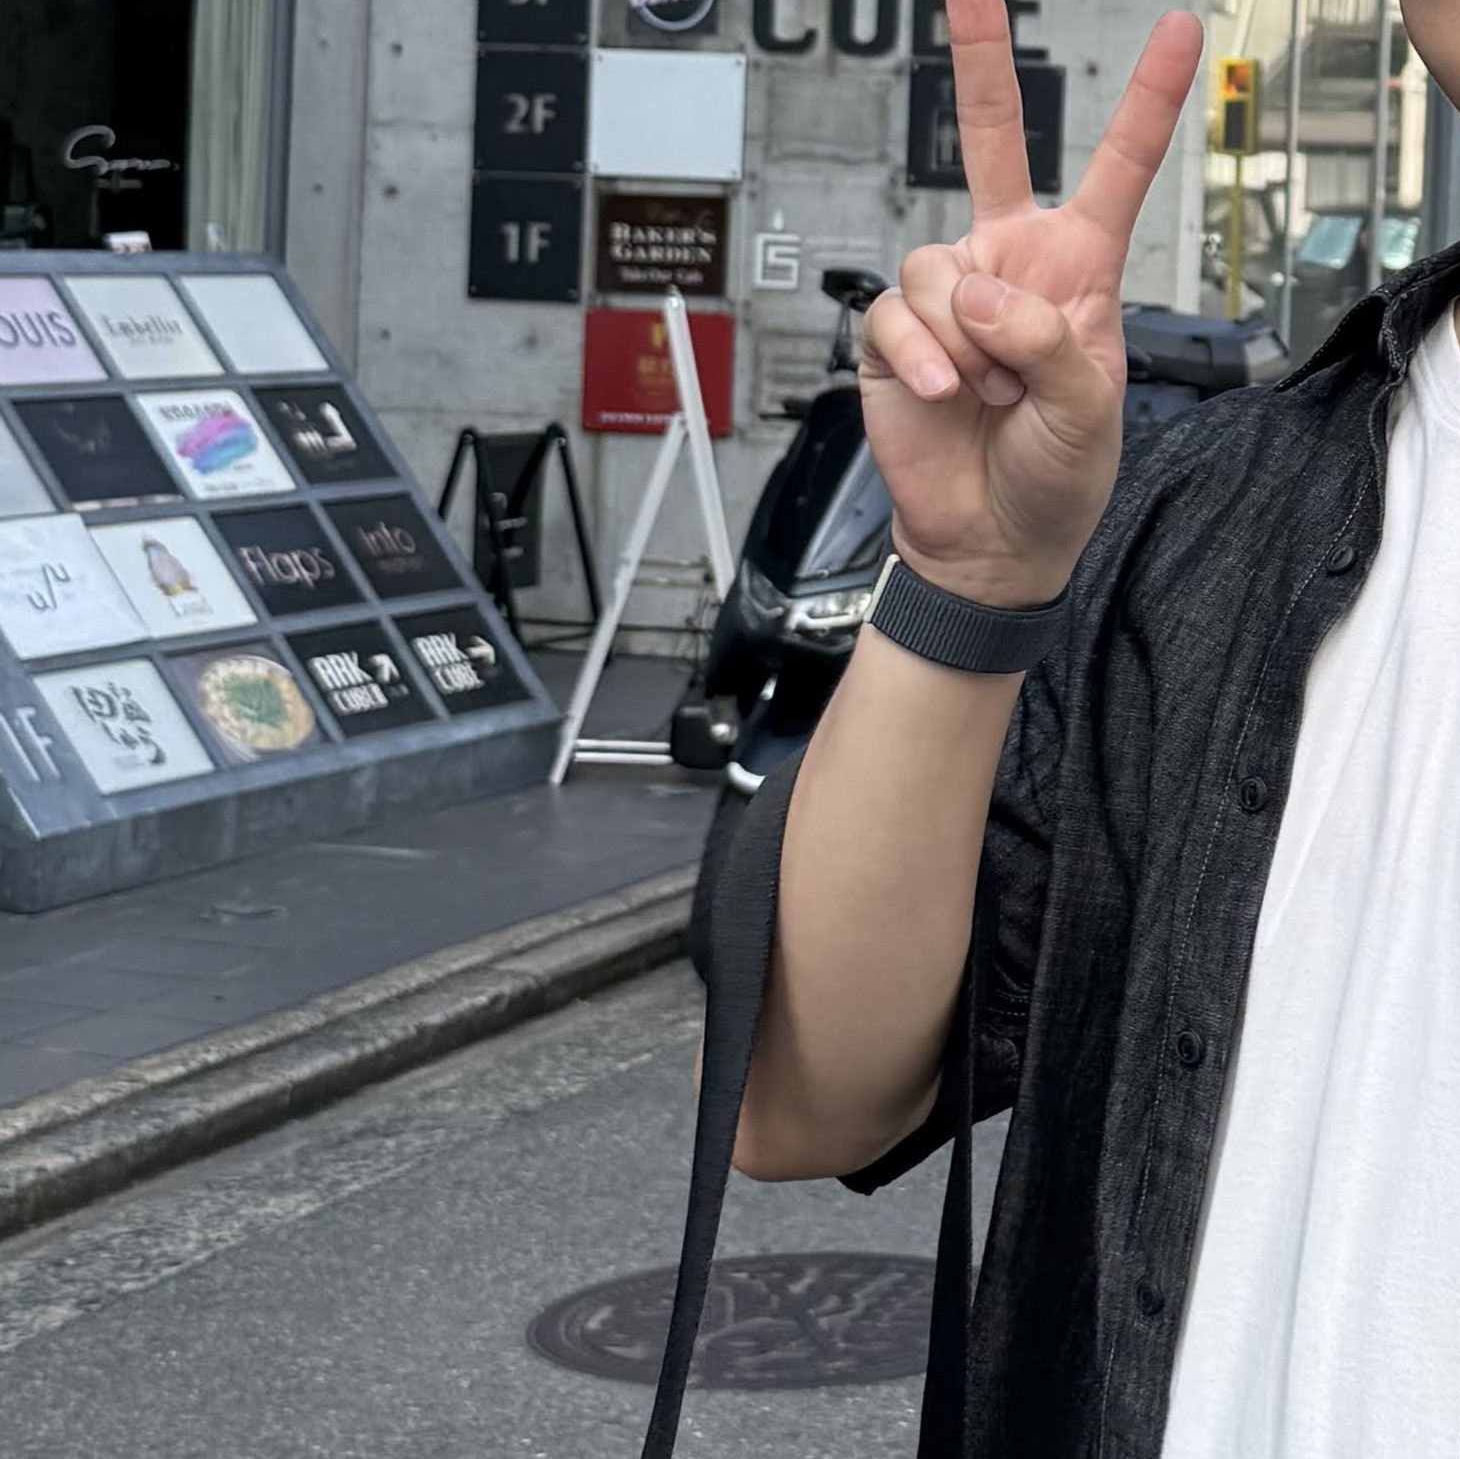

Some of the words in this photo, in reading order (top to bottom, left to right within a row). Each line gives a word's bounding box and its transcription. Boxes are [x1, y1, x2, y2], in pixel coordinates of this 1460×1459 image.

[503, 92, 557, 134] 2F
[501, 221, 551, 264] 1F
[609, 242, 713, 264] GARDEN
[239, 545, 335, 589] Flaps
